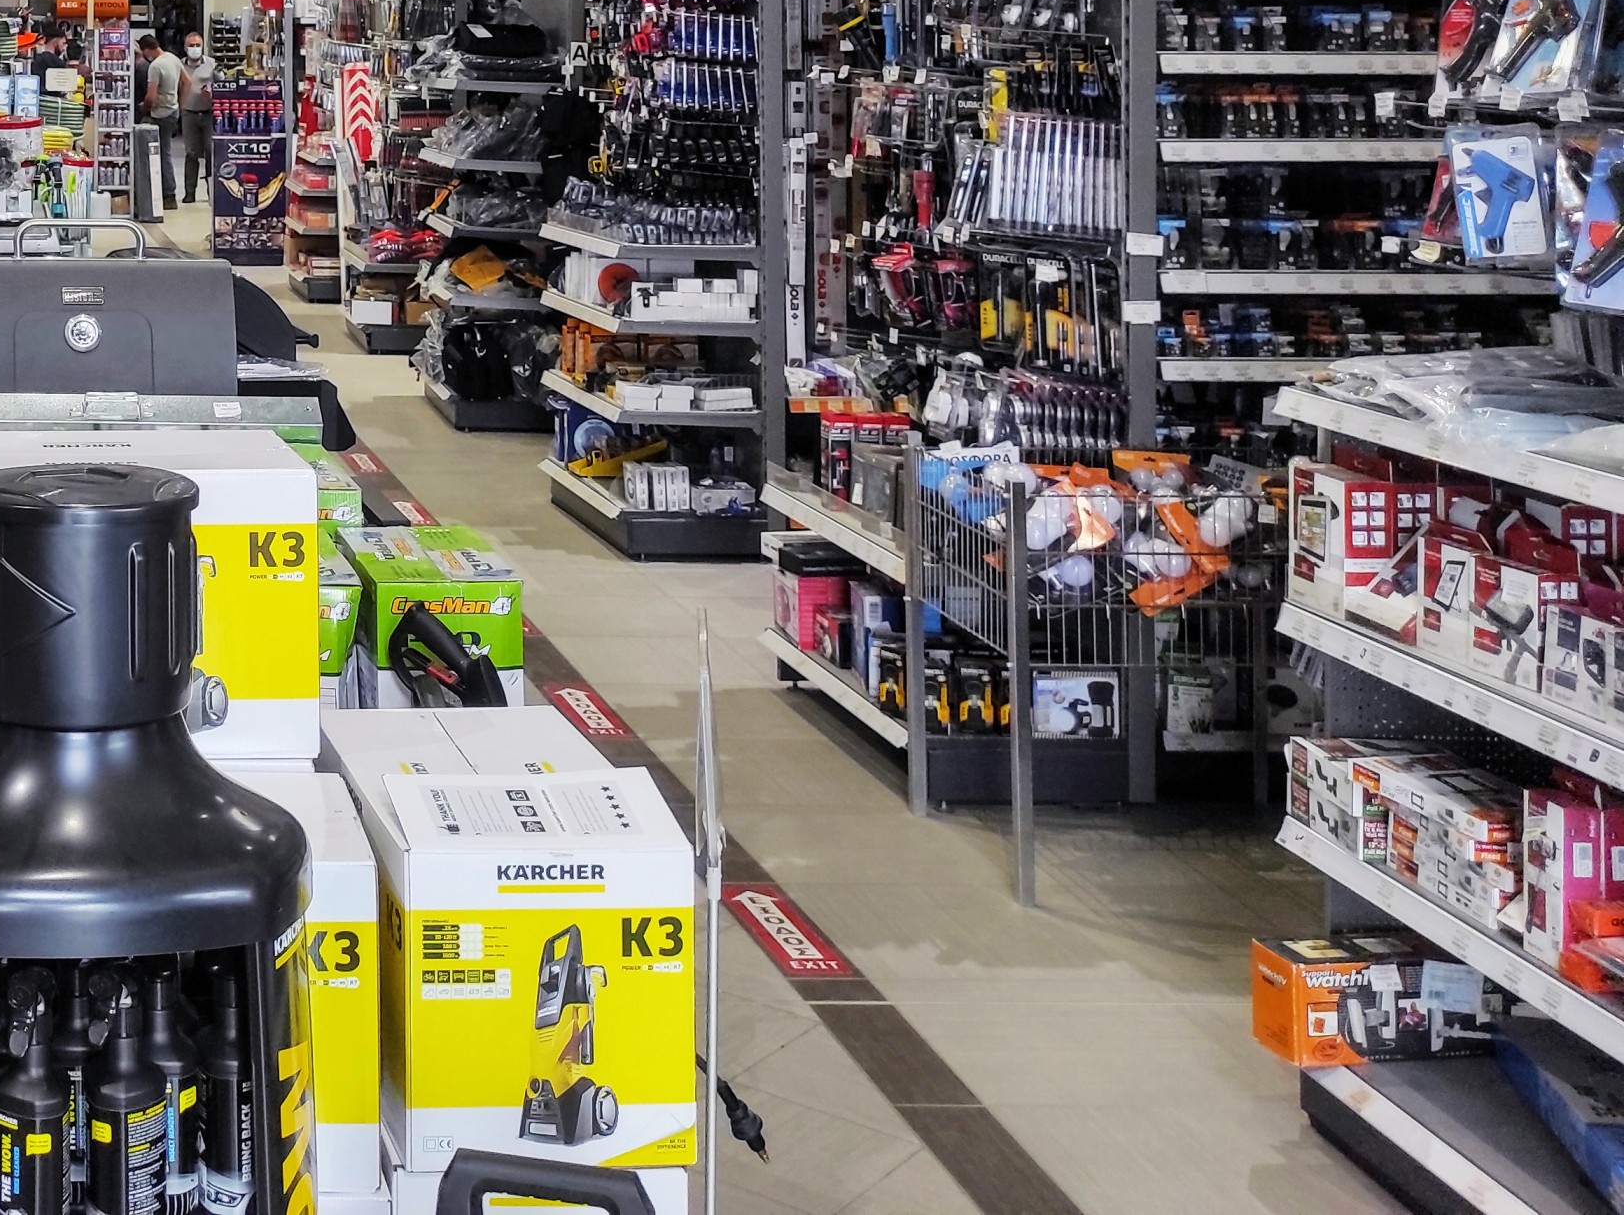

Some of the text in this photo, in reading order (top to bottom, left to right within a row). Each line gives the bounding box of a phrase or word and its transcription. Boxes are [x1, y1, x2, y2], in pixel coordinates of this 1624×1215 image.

[572, 46, 588, 63] A
[958, 100, 984, 109] DURAC
[228, 142, 271, 153] XT10
[983, 253, 1023, 265] DURACELL
[1027, 257, 1065, 269] DURACELL
[790, 286, 800, 310] OLA
[249, 531, 305, 567] K3
[391, 596, 491, 615] CsMan
[587, 728, 624, 736] EXIT
[496, 863, 605, 882] KÄRCHER
[621, 916, 684, 957] K3
[789, 959, 839, 970] EXIT
[1301, 969, 1335, 979] Support
[1306, 969, 1371, 988] watchT
[241, 1103, 253, 1183] BRING BACK
[1, 1133, 12, 1202] THE WOW.
